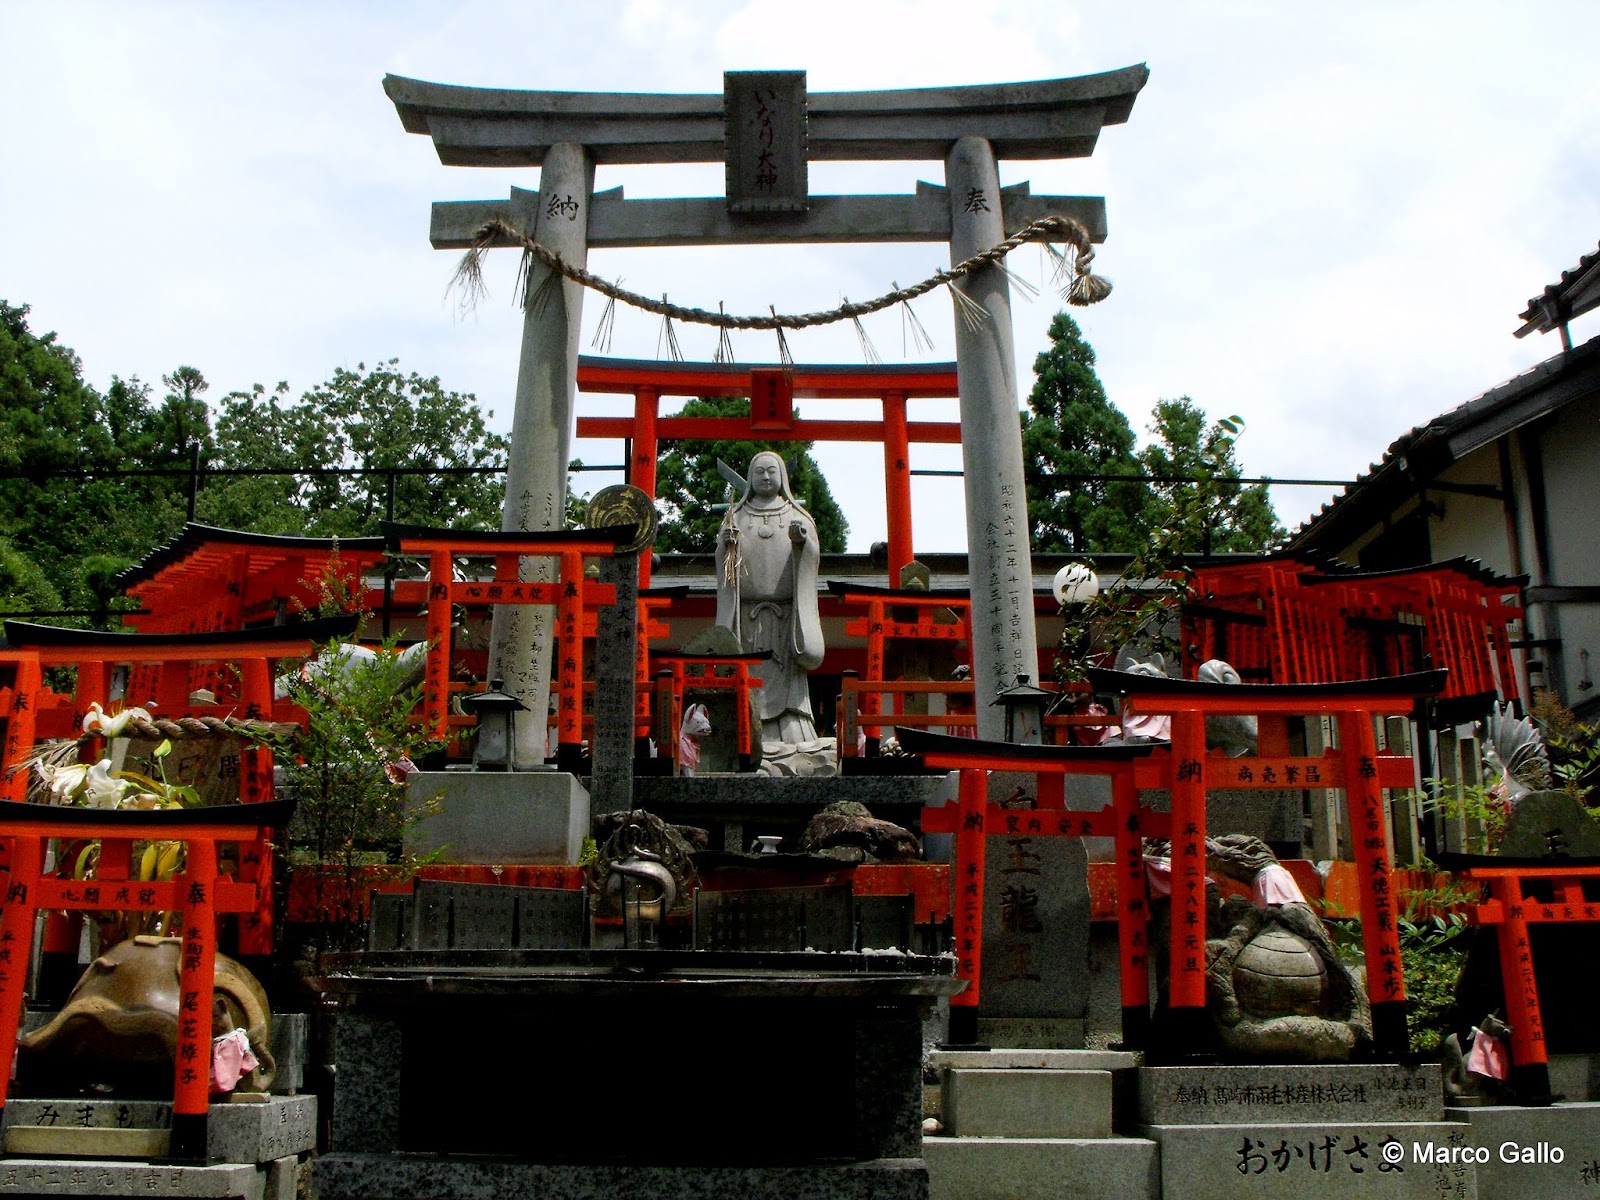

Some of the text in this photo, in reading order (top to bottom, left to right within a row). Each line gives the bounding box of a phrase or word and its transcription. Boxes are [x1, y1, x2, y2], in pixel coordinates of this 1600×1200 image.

[546, 192, 579, 222] 納
[964, 187, 991, 215] 奉
[1176, 758, 1203, 785] 納
[1237, 764, 1322, 785] 商売繁昌
[1356, 756, 1377, 782] 奉
[962, 810, 984, 834] 納
[187, 881, 206, 910] 奉
[1182, 823, 1202, 973] 平成二十八年元旦
[36, 1103, 172, 1129] みまもり
[1236, 1134, 1404, 1176] おかげさま
